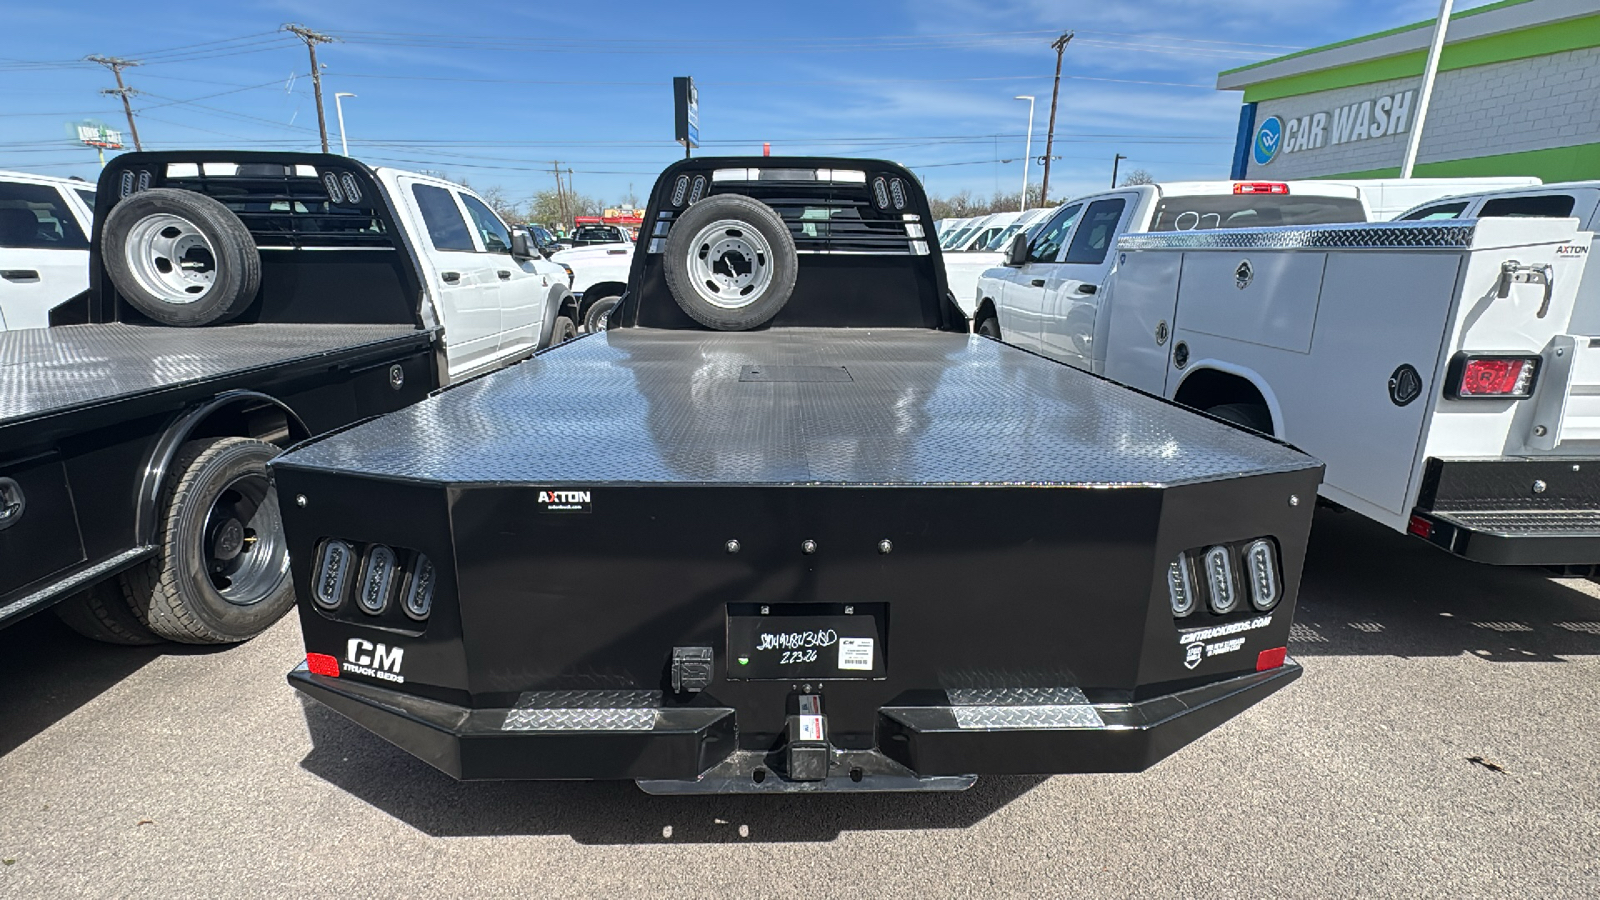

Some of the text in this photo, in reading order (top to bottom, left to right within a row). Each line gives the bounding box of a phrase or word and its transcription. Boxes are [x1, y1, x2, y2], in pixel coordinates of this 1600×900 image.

[1282, 91, 1414, 154] CAR WASH
[1555, 245, 1589, 254] AXTON
[537, 491, 591, 503] AXTON
[347, 637, 404, 674] CM
[342, 662, 405, 684] TRUCK BEDS
